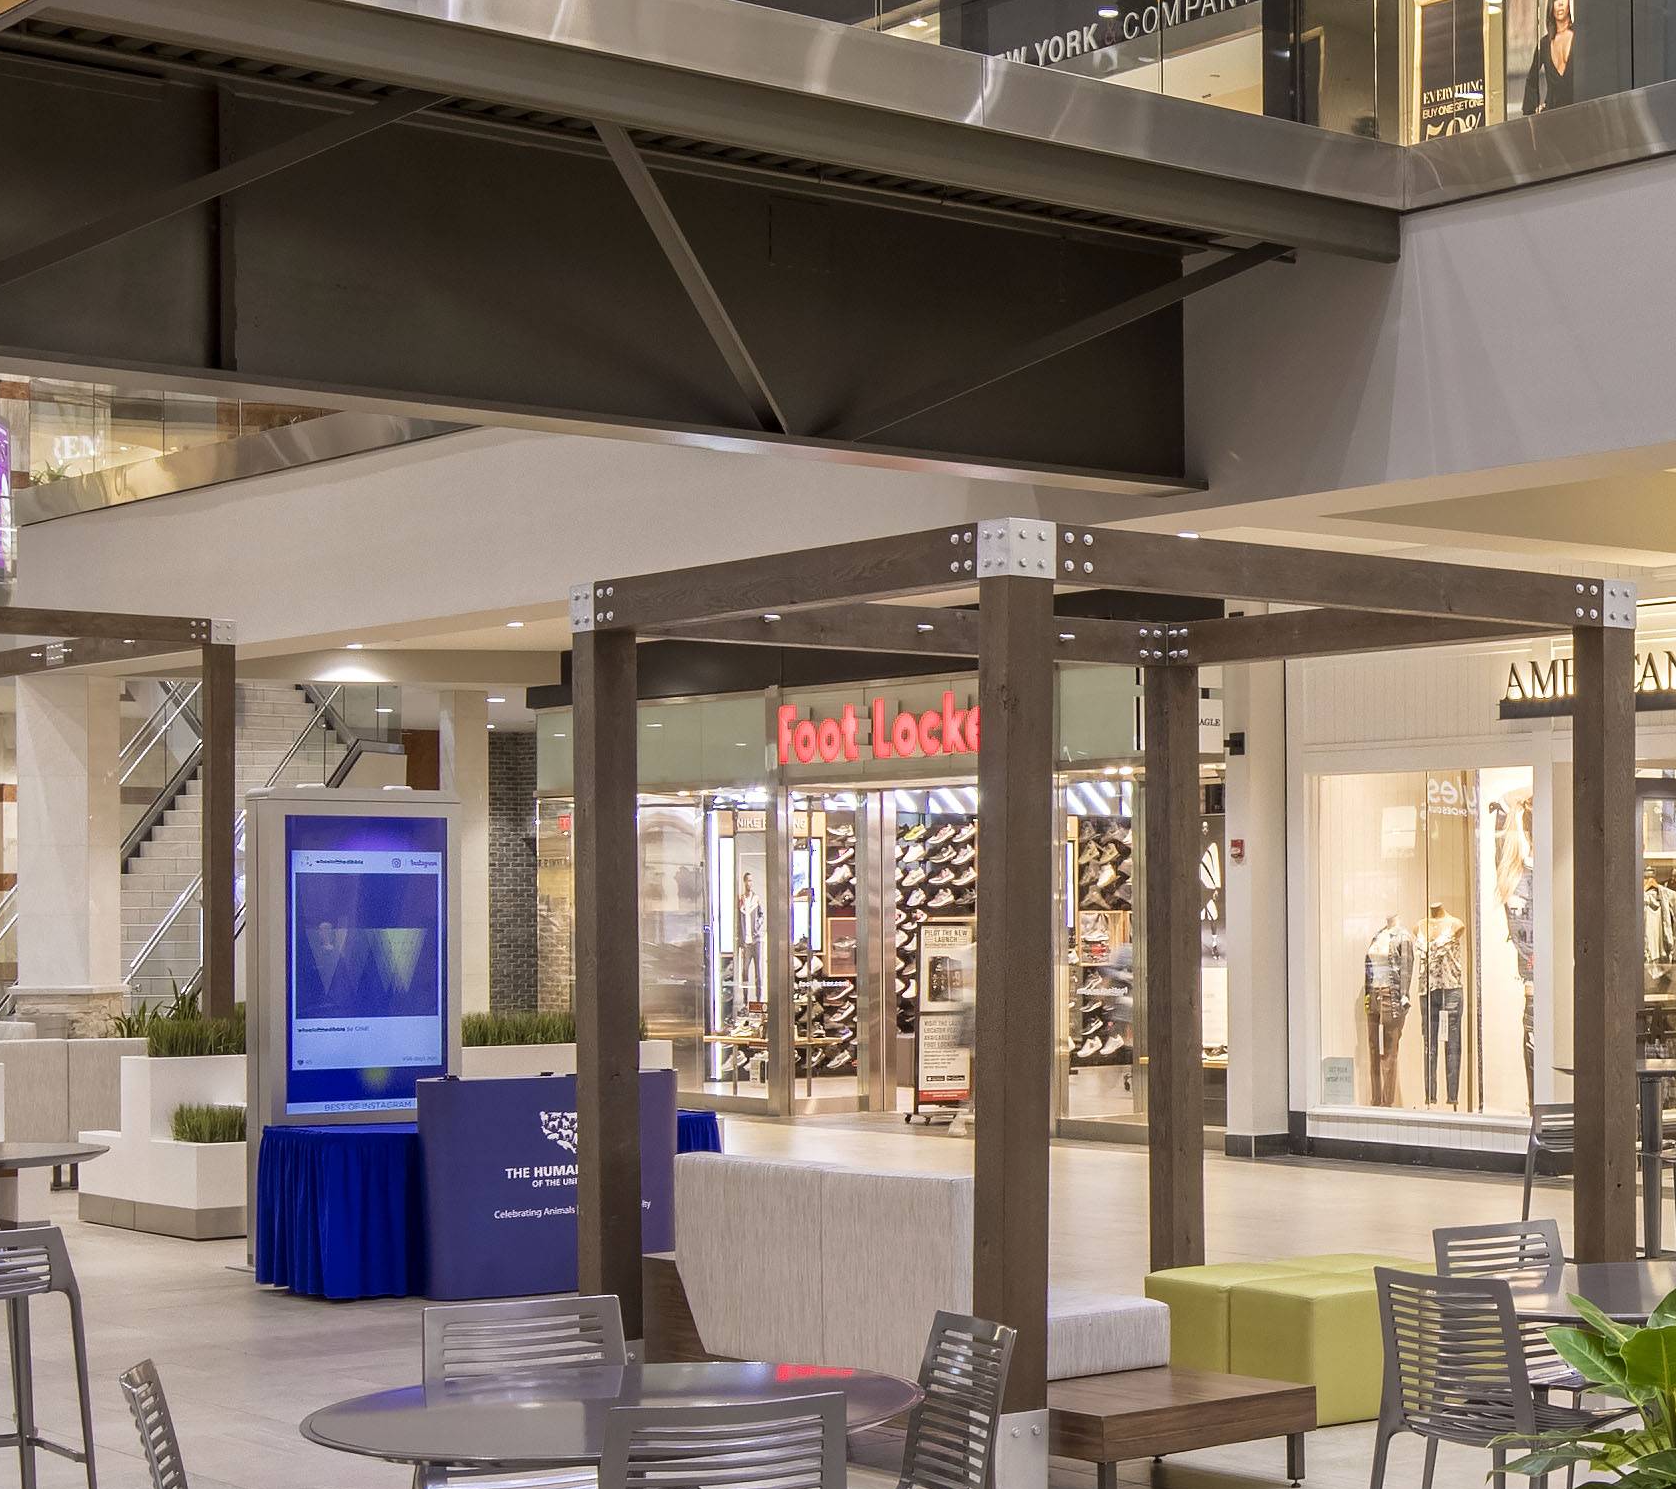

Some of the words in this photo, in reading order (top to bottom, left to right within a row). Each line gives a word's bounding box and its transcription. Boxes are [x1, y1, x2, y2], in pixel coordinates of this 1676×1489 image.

[1034, 22, 1098, 67] YORK
[1423, 107, 1438, 119] BUY
[1438, 103, 1454, 115] ONE
[1468, 99, 1484, 109] ONE
[778, 704, 860, 764] Foot
[872, 691, 980, 759] Locke
[1196, 718, 1221, 726] AGLE
[736, 818, 760, 828] NIKE
[505, 1167, 530, 1179] THE
[533, 1165, 578, 1178] HUMA
[531, 1179, 543, 1188] OF
[545, 1178, 561, 1187] THE
[493, 1206, 542, 1219] Celebrating
[543, 1205, 576, 1216] Animals
